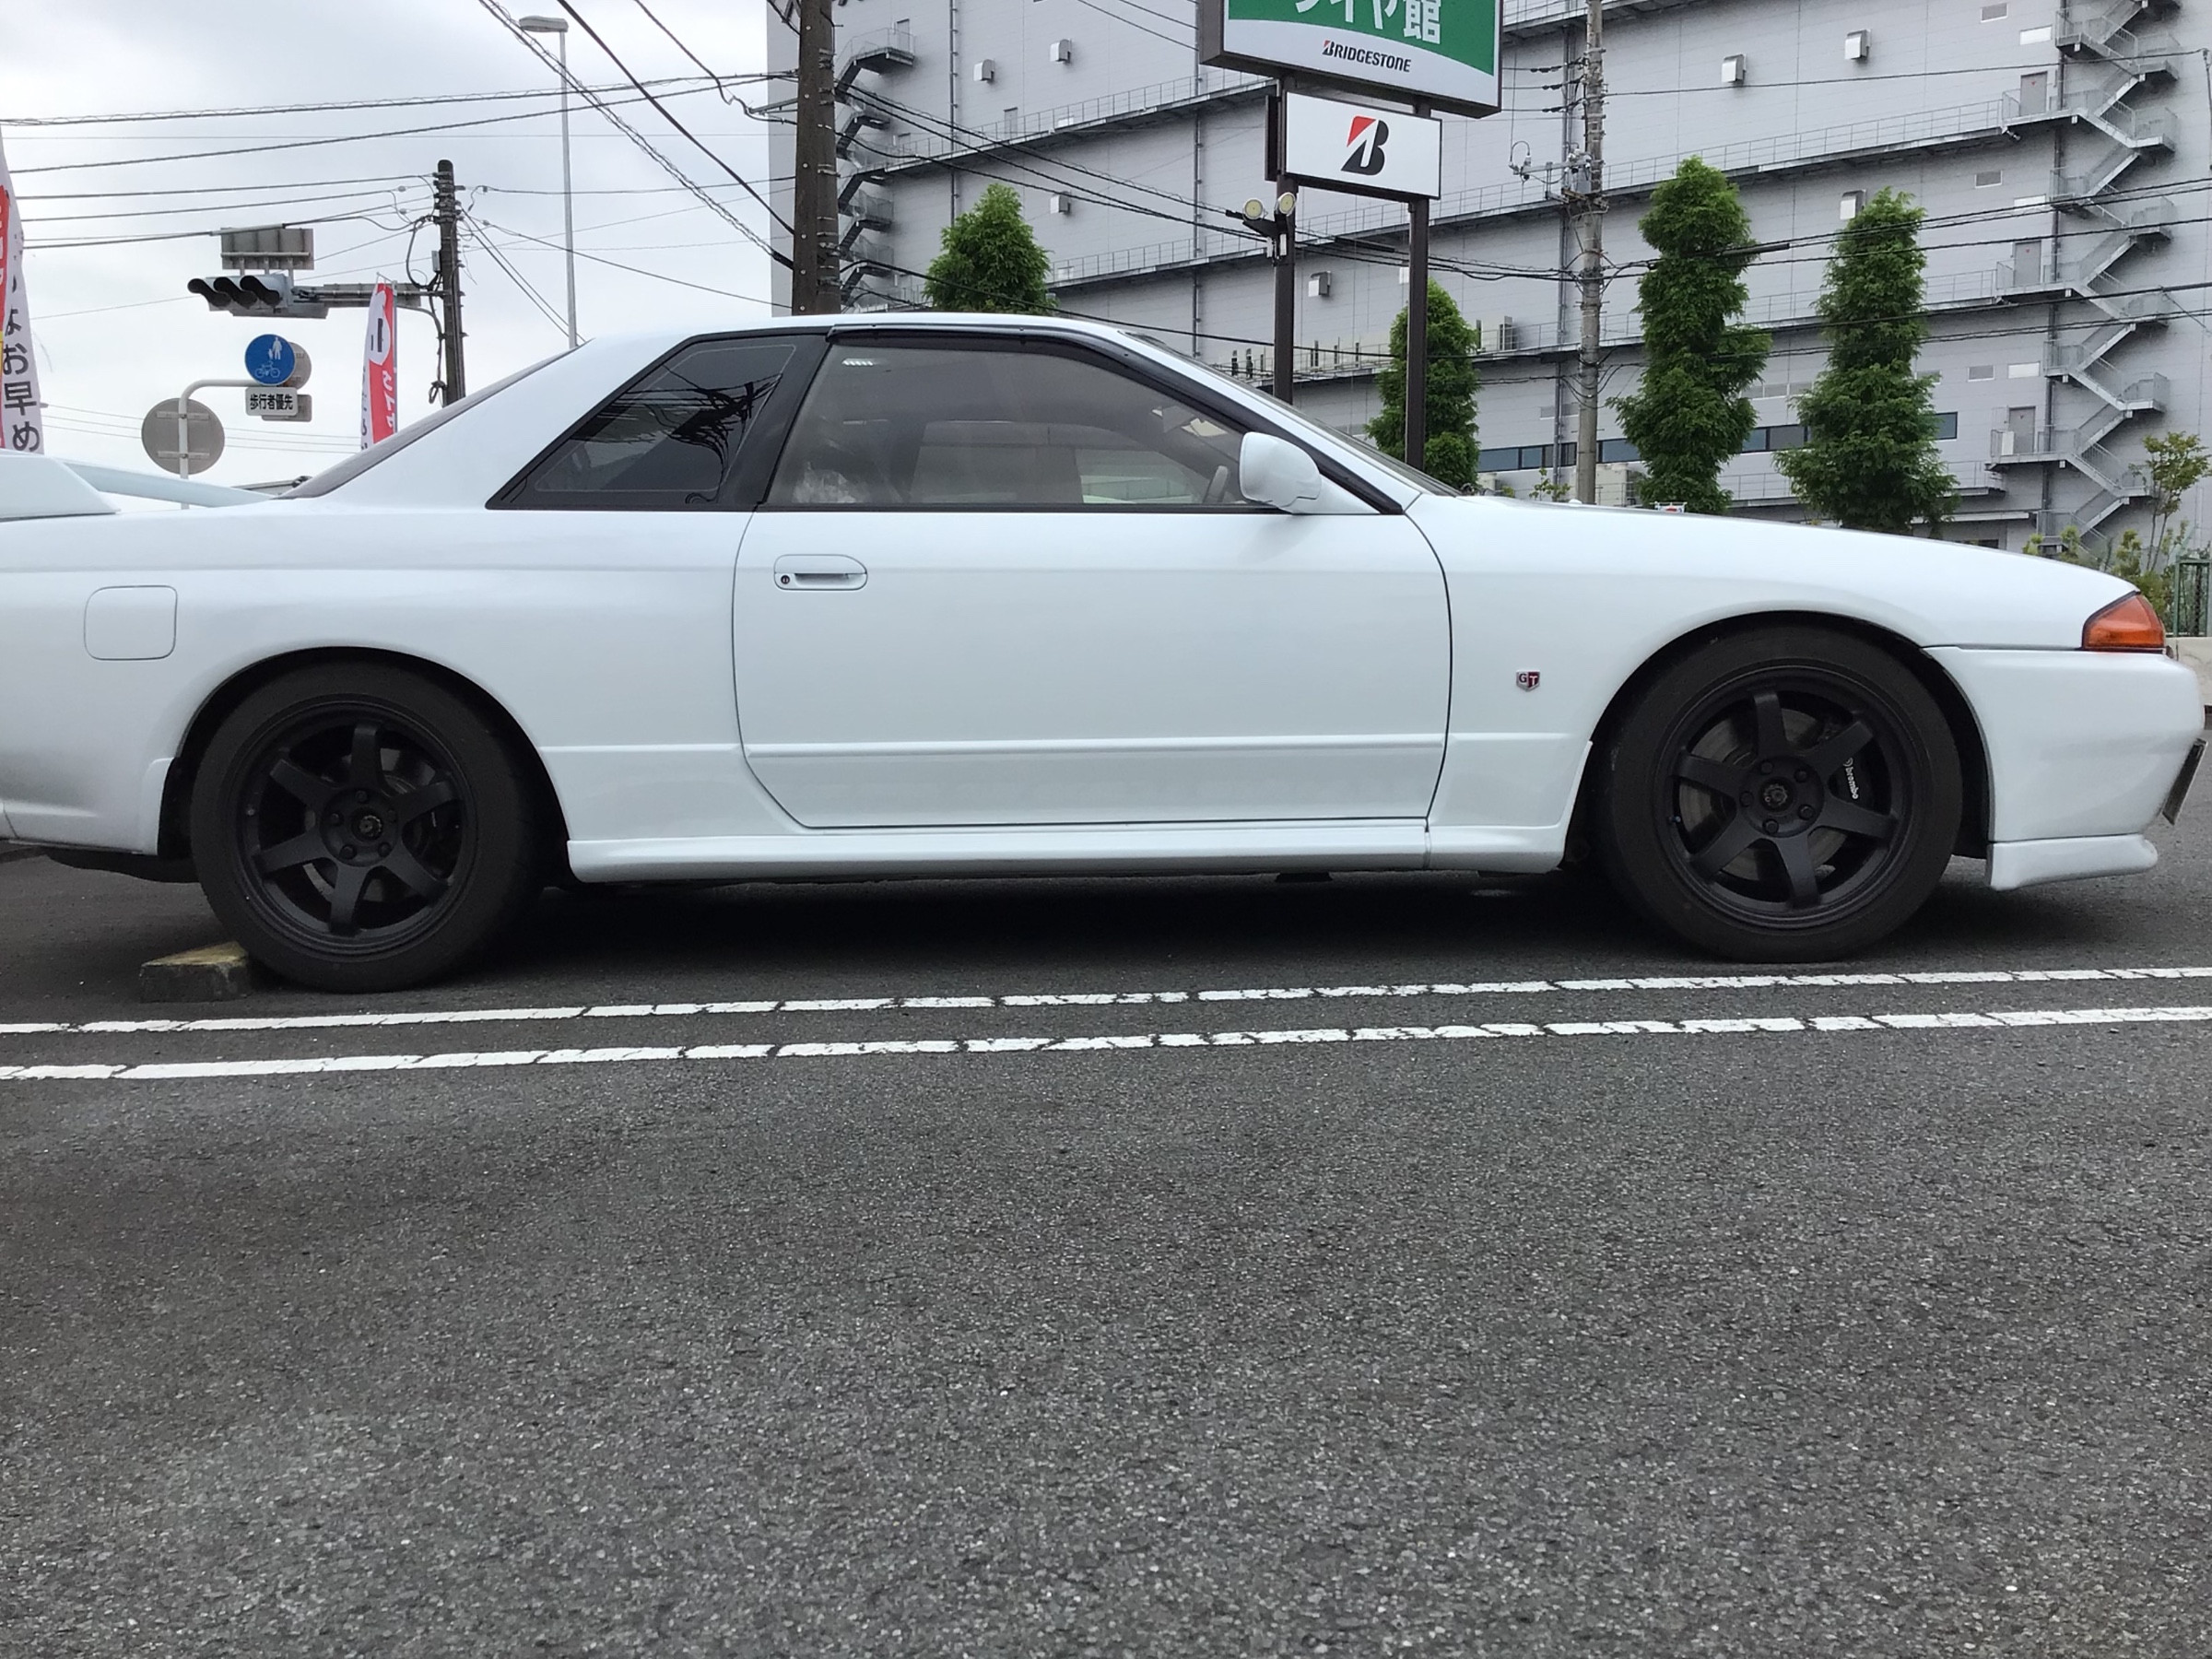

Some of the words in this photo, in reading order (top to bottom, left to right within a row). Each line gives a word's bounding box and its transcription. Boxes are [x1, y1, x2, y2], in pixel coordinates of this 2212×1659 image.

[1322, 40, 1412, 73] BRIDGESTONE
[250, 394, 294, 411] 歩行者優先
[1518, 673, 1538, 686] GT
[1845, 766, 1860, 800] brembo
